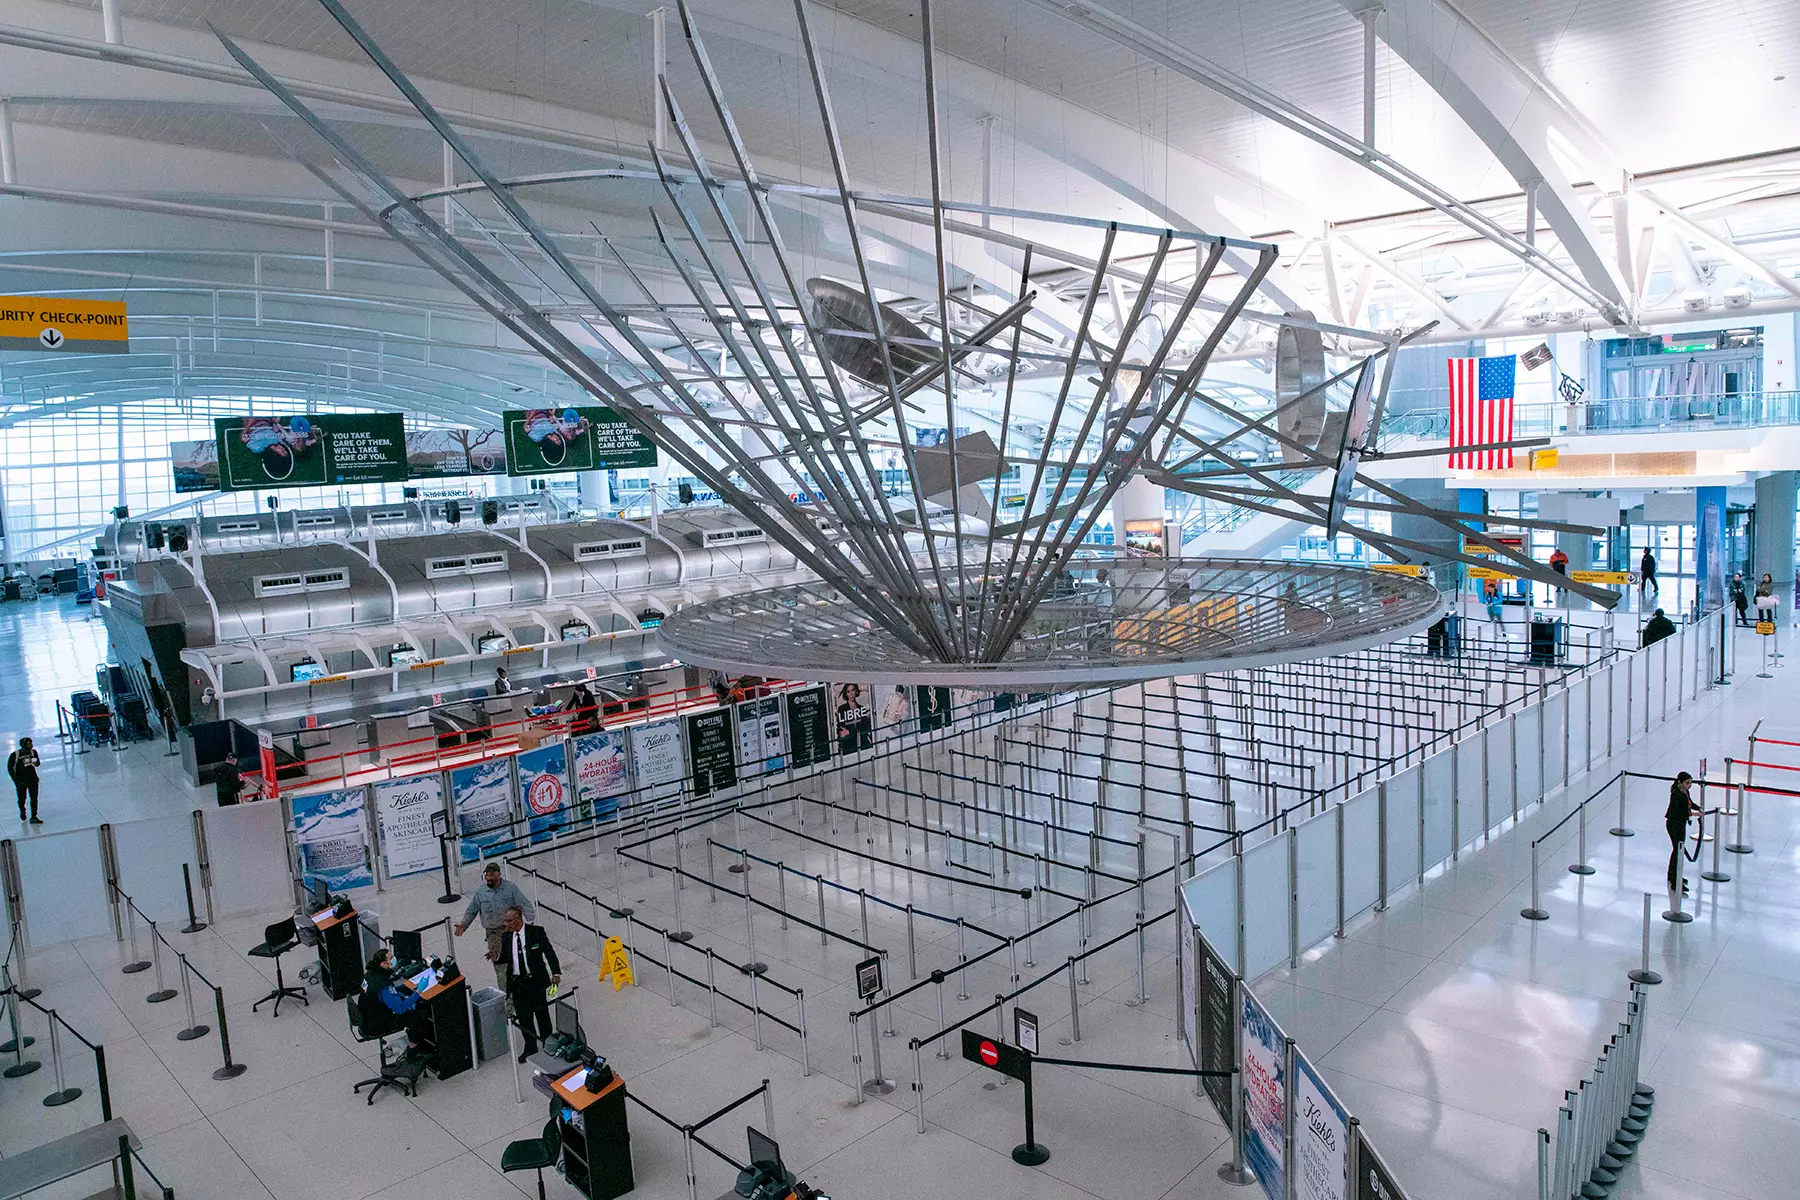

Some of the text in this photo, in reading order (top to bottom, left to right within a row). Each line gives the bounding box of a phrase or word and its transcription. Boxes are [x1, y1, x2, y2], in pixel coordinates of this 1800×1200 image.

[40, 311, 124, 326] CHECK-POINT
[334, 454, 356, 462] CARE
[357, 453, 367, 461] OF
[838, 706, 867, 723] LIBRE
[642, 733, 671, 748] Kiehl's
[640, 756, 677, 770] APOTHECARY
[647, 751, 668, 761] FINEST
[579, 764, 624, 779] HYDRATION
[584, 757, 617, 771] 24-HOUR
[389, 791, 430, 808] Kiehl's
[538, 785, 553, 802] #1
[397, 812, 425, 823] FINEST
[386, 819, 432, 832] APOTHECA
[1248, 1049, 1277, 1094] 24-HOUR
[1303, 1096, 1336, 1152] Kiehl's
[1308, 1142, 1330, 1181] FINEST
